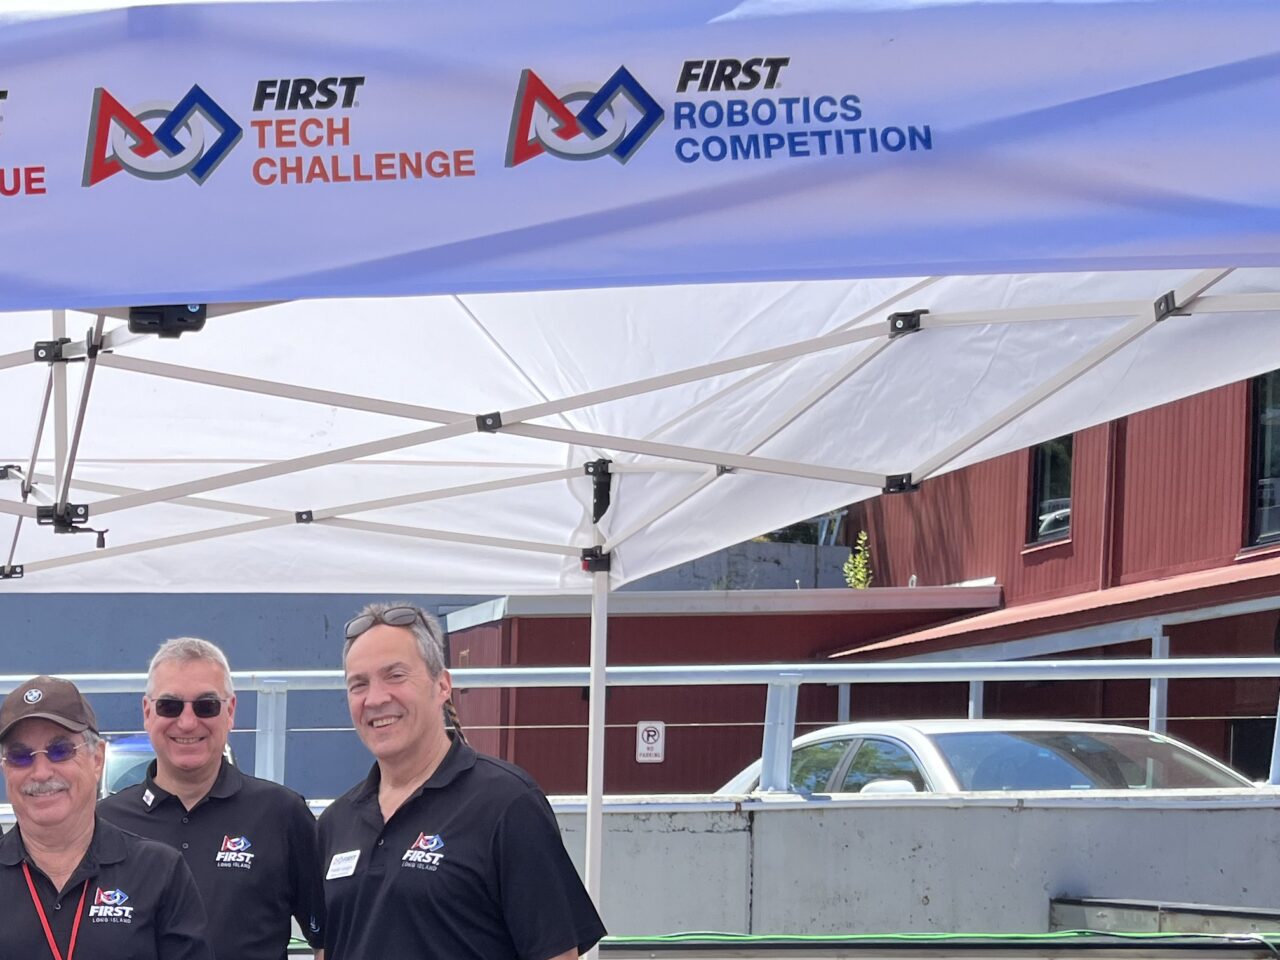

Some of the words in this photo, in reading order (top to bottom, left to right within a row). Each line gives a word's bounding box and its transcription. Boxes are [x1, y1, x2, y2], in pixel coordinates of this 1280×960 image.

[677, 58, 789, 93] FIRST
[253, 77, 365, 111] FIRST
[673, 96, 862, 131] ROBOTICS
[250, 118, 350, 151] TECH
[675, 125, 933, 164] COMPETITION
[251, 149, 476, 187] CHALLENGE
[216, 851, 254, 864] FIRST
[402, 850, 444, 865] FIRST
[89, 905, 133, 918] FIRST
